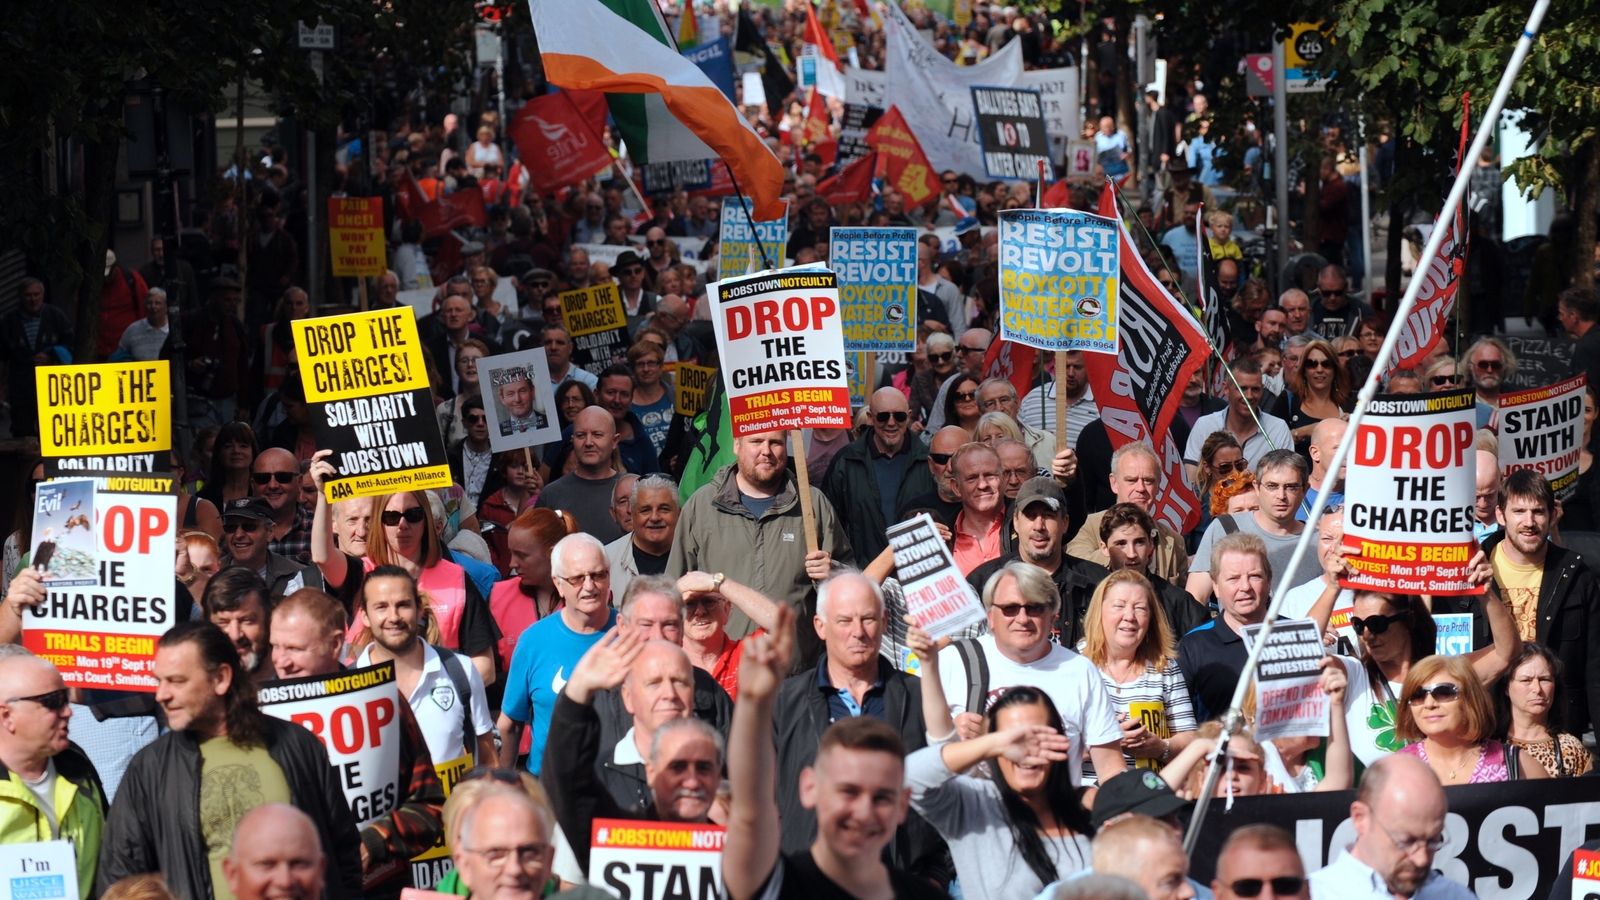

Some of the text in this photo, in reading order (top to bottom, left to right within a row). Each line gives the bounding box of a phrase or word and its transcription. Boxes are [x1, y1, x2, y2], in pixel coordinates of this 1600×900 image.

[340, 199, 369, 210] PAID
[337, 214, 374, 225] ONCE!
[1003, 212, 1115, 228] People Before Profit
[340, 232, 375, 241] WON'T
[834, 232, 914, 240] People Before Profit
[1003, 221, 1115, 249] RESIST
[349, 245, 367, 253] PAY
[833, 241, 915, 260] RESIST
[1002, 245, 1116, 273] REVOLT
[339, 257, 377, 265] TWICE!
[834, 263, 915, 282] REVOLT
[1002, 269, 1103, 296] BOYCOTT
[722, 276, 833, 299] #JOBSTOWNNOTGUILTY
[563, 287, 614, 312] DROP THE
[1003, 290, 1074, 316] WATER
[569, 307, 618, 332] CHARGES!
[726, 297, 836, 341] DROP
[304, 315, 407, 357] DROP THE
[576, 329, 620, 350] SOLIDARITY
[761, 336, 806, 358] THE
[1006, 330, 1022, 340] Text
[1024, 335, 1044, 345] JOIN
[1093, 341, 1114, 350] 9964
[1506, 337, 1551, 356] PIZZA
[590, 345, 611, 362] WITH
[313, 352, 413, 393] CHARGES!
[732, 360, 841, 389] CHARGES
[1517, 359, 1546, 372] EER
[48, 368, 157, 407] DROP THE
[1501, 377, 1584, 406] #JOBSTOWNNOTGUILTY
[324, 392, 417, 428] SOLIDARITY
[745, 390, 833, 409] TRIALS BEGIN
[1356, 394, 1473, 414] JOBSTOWNNOTGUILTY
[734, 409, 771, 423] PROTEST:
[772, 408, 790, 417] Mon
[808, 405, 828, 415] Sept
[739, 416, 844, 433] Children's Court, Smithfield
[1504, 395, 1582, 434] STAND
[52, 409, 156, 447] CHARGES!
[354, 421, 398, 449] WITH
[1354, 421, 1474, 469] DROP
[1514, 425, 1575, 460] WITH
[339, 441, 429, 476] JOBSTOWN
[331, 482, 354, 499] AAA
[356, 474, 412, 489] Anti-Austerity
[414, 471, 446, 482] Alliance
[1393, 476, 1445, 501] THE
[1551, 471, 1578, 491] BEGIN
[38, 493, 62, 514] Evil
[1351, 503, 1474, 533] CHARGES
[95, 505, 169, 554] OP
[1361, 541, 1468, 562] TRIALS BEGIN
[1390, 565, 1412, 576] Mon
[1436, 568, 1458, 579] Sept
[934, 575, 960, 597] OUR
[1397, 578, 1427, 591] Court,
[911, 591, 972, 629] OMMUNITY!
[1297, 628, 1318, 641] THE
[1451, 621, 1469, 633] Profit
[44, 633, 154, 655] TRIALS BEGIN
[76, 656, 98, 668] Mon
[122, 659, 144, 673] Sept
[84, 671, 113, 686] Court,
[115, 673, 159, 686] Smithfie
[1263, 686, 1299, 708] DEFEND
[1261, 701, 1323, 727] COMMUNITY!
[20, 858, 50, 873] I'm
